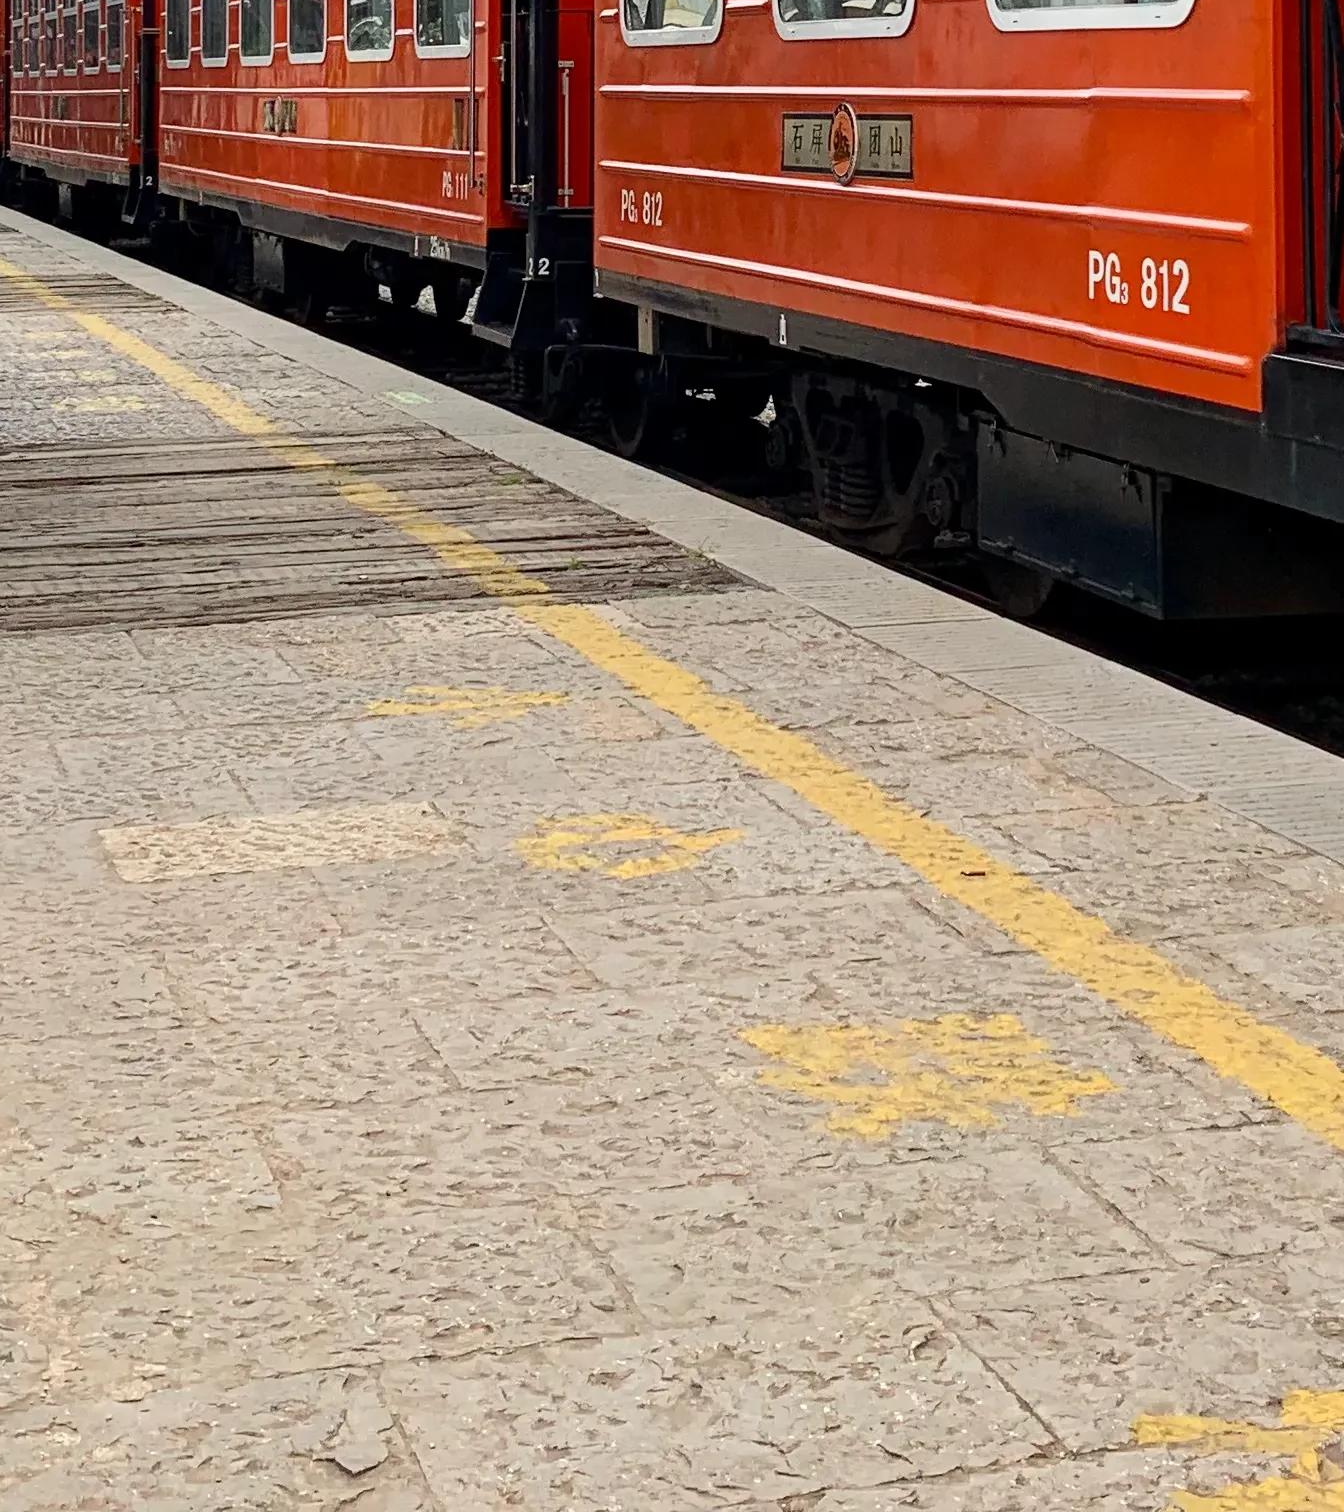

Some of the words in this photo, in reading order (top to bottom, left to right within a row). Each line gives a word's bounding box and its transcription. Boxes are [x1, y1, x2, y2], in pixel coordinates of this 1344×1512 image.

[791, 123, 823, 154] 石屏
[869, 125, 903, 157] 团山
[643, 191, 663, 226] 812
[1141, 257, 1190, 314] 812
